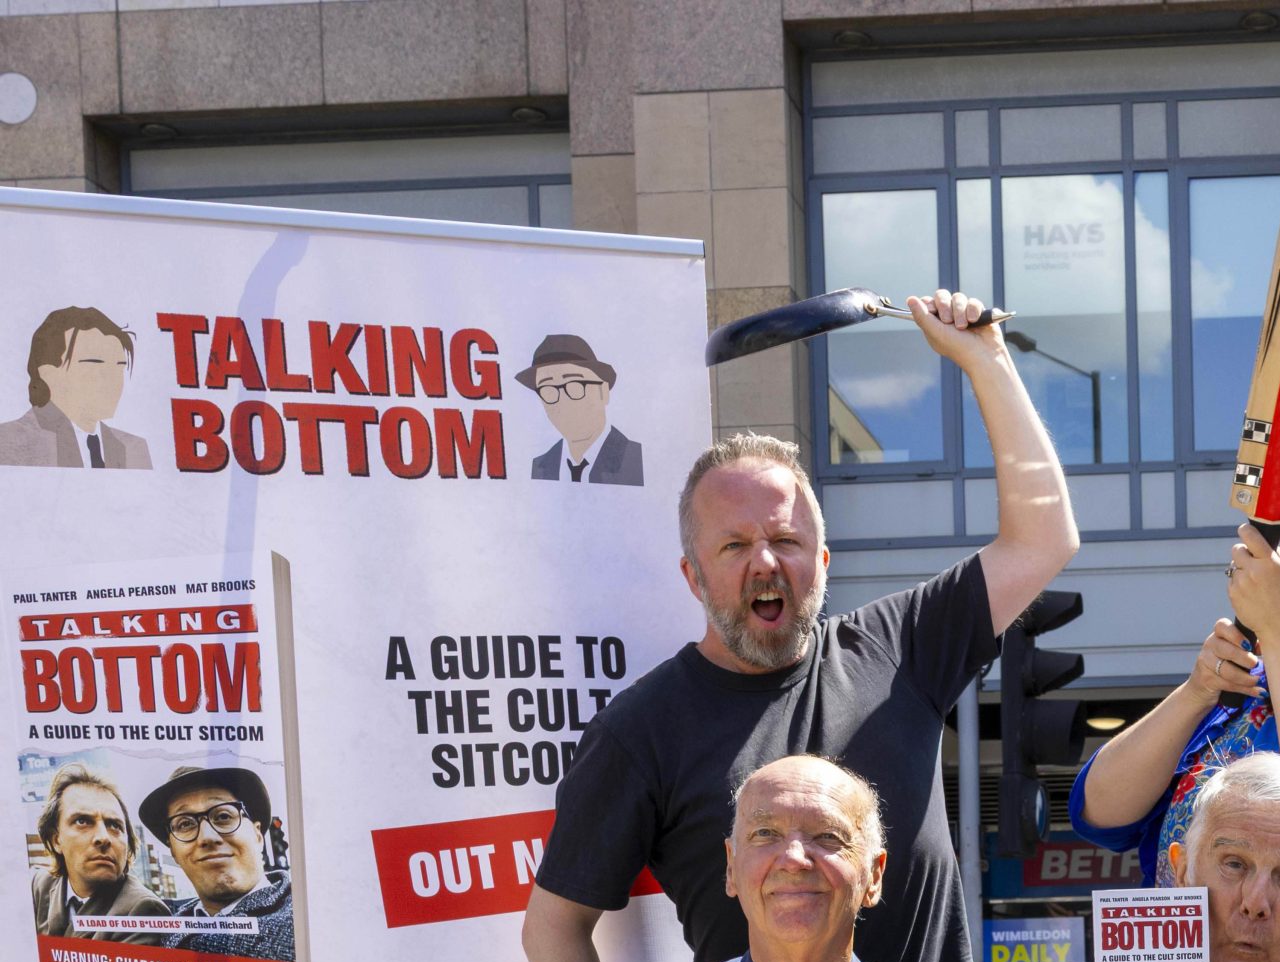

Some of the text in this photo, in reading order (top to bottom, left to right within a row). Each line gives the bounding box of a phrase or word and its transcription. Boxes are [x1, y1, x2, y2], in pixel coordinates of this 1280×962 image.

[1024, 223, 1105, 246] HAYS
[156, 312, 502, 400] TALKING
[170, 397, 507, 479] BOTTOM
[14, 579, 255, 603] PAUL TANTER ANGELA PEARSON MAT BROOKS
[31, 609, 241, 638] TALKING
[385, 635, 626, 680] A GUIDE TO
[20, 642, 261, 714] BOTTOM
[408, 690, 493, 734] THE
[29, 725, 264, 742] A GUIDE TO THE CULT SITCOM
[409, 844, 495, 898] OUT
[1041, 849, 1140, 881] BETF
[86, 920, 106, 928] LOAD
[109, 920, 119, 928] OF
[122, 920, 137, 928] OLD
[185, 921, 217, 929] Richard
[220, 921, 252, 929] Richard
[1108, 907, 1196, 917] TALKING
[992, 930, 1071, 942] WIMBLEDON
[1101, 920, 1202, 950] BOTTOM
